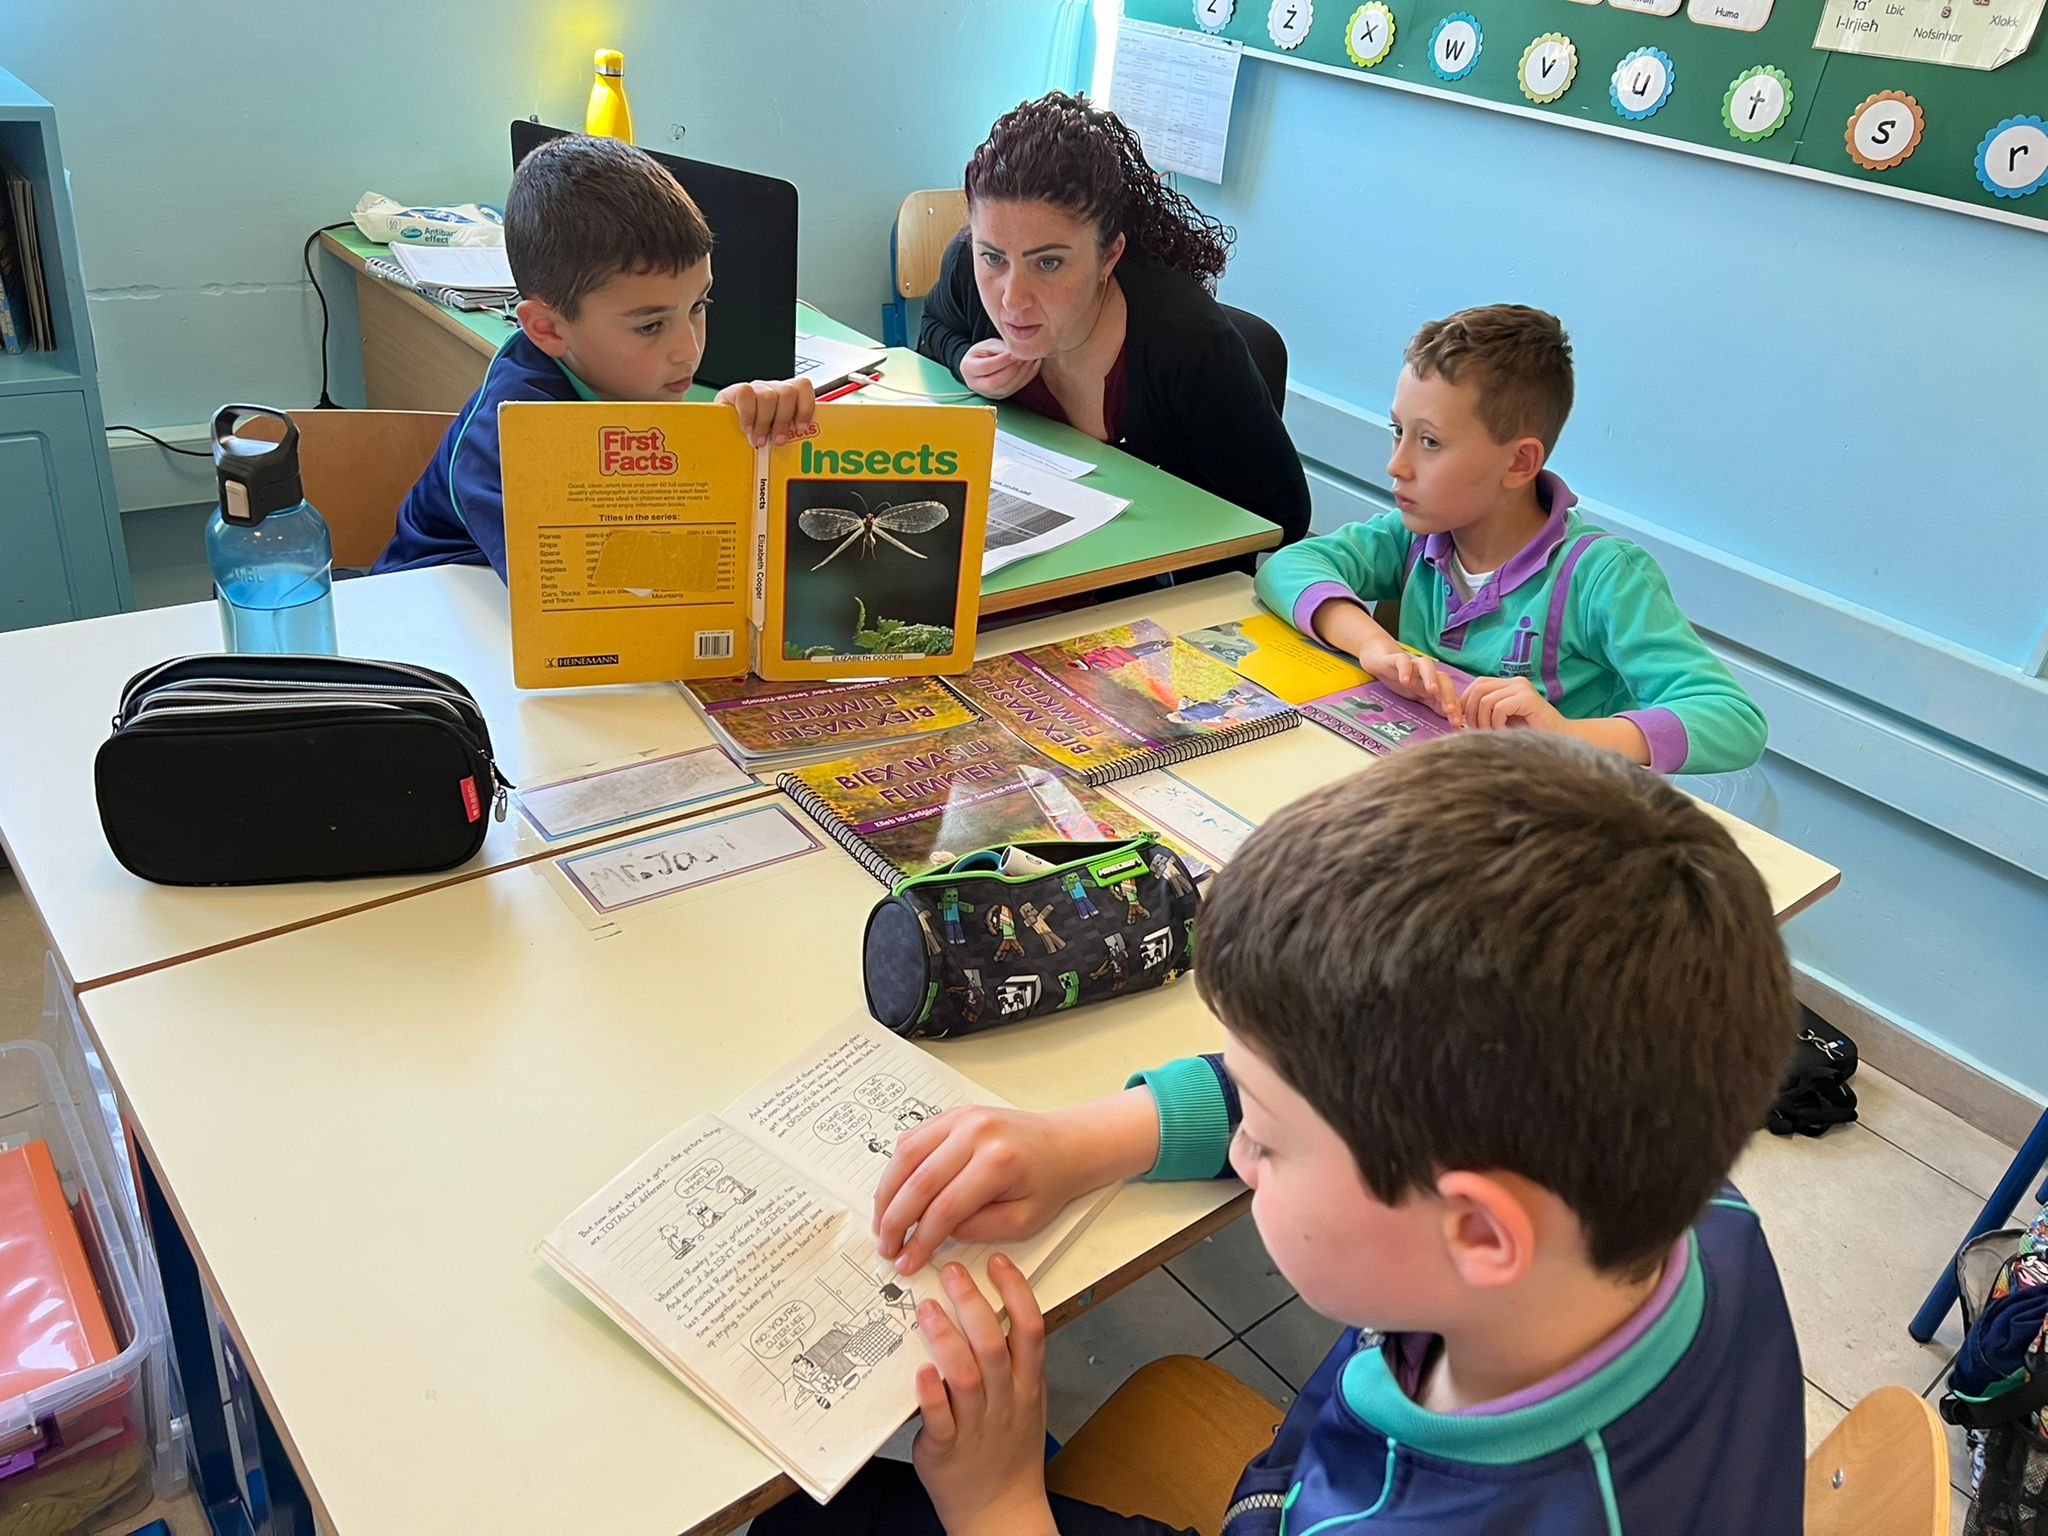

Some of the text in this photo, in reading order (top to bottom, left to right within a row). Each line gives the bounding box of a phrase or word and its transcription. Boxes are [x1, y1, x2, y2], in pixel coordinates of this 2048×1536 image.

[1714, 7, 1740, 20] Huma
[1913, 27, 1963, 43] Nofsinhar
[1631, 71, 1651, 97] u
[1749, 90, 1766, 120] t
[1871, 120, 1897, 144] s
[2009, 145, 2029, 172] r
[425, 235, 449, 243] effect
[604, 431, 659, 451] First
[604, 452, 673, 471] Facts
[800, 440, 958, 475] Insects
[759, 478, 767, 510] Insects
[598, 514, 623, 522] Titles
[651, 513, 681, 521] series:
[755, 534, 765, 600] Elizabeth Cooper
[559, 656, 618, 666] HEINEMANN
[832, 654, 904, 662] ELIZABETH COOPER
[766, 693, 899, 725] FLIMKIEN
[767, 704, 937, 741] BIEX NASLU
[970, 675, 1093, 755] BIEX NASLU
[1005, 676, 1104, 739] FLIMKIEN
[834, 739, 994, 791] BIEX NASLU
[877, 759, 1007, 805] FLIMKIEN
[578, 1226, 594, 1238] But
[671, 1153, 682, 1164] the
[599, 1201, 638, 1238] TOTALLY
[638, 1179, 671, 1205] different.
[666, 1296, 682, 1312] And
[682, 1285, 698, 1298] even
[713, 1246, 737, 1269] ISN'T
[759, 1205, 785, 1230] SEEMS
[683, 1303, 694, 1313] I
[712, 1265, 744, 1293] Rowley
[737, 1258, 746, 1267] to
[746, 1249, 757, 1260] my
[753, 1236, 772, 1251] house
[770, 1226, 783, 1237] for
[683, 1316, 701, 1329] last
[700, 1290, 727, 1317] weekend
[735, 1274, 748, 1285] the
[747, 1263, 760, 1274] two
[761, 1252, 770, 1264] of
[777, 1233, 793, 1250] could
[793, 1218, 810, 1237] spend
[684, 1257, 710, 1277] Rowley
[696, 1215, 837, 1338] time together, but after about two hours I gave
[715, 1320, 739, 1341] trying
[736, 1312, 747, 1322] to
[742, 1299, 761, 1313] have
[760, 1288, 773, 1300] any
[767, 1299, 801, 1331] YOU'RE
[765, 1324, 792, 1351] CUTER!
